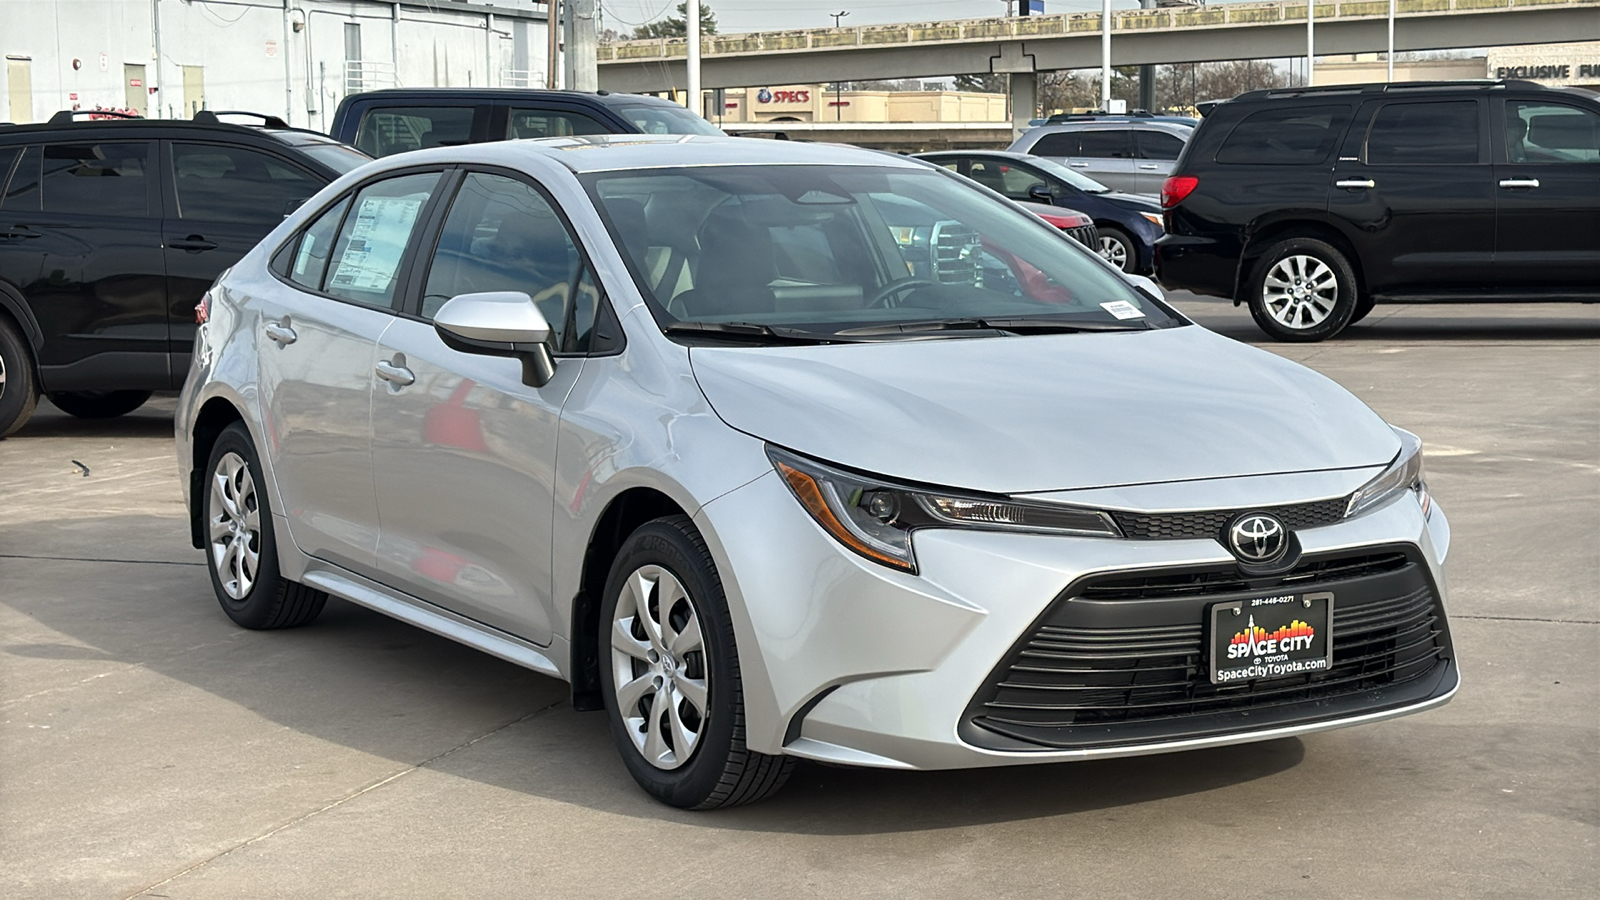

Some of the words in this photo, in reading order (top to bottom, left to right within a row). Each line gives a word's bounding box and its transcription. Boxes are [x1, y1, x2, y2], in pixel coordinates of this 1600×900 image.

[1497, 65, 1570, 79] EXCLUSIVE
[1227, 626, 1278, 659] SPACE
[1280, 634, 1315, 653] CITY
[1265, 654, 1289, 663] TOYOTA
[1217, 659, 1327, 682] SpaceCityToyota.com
